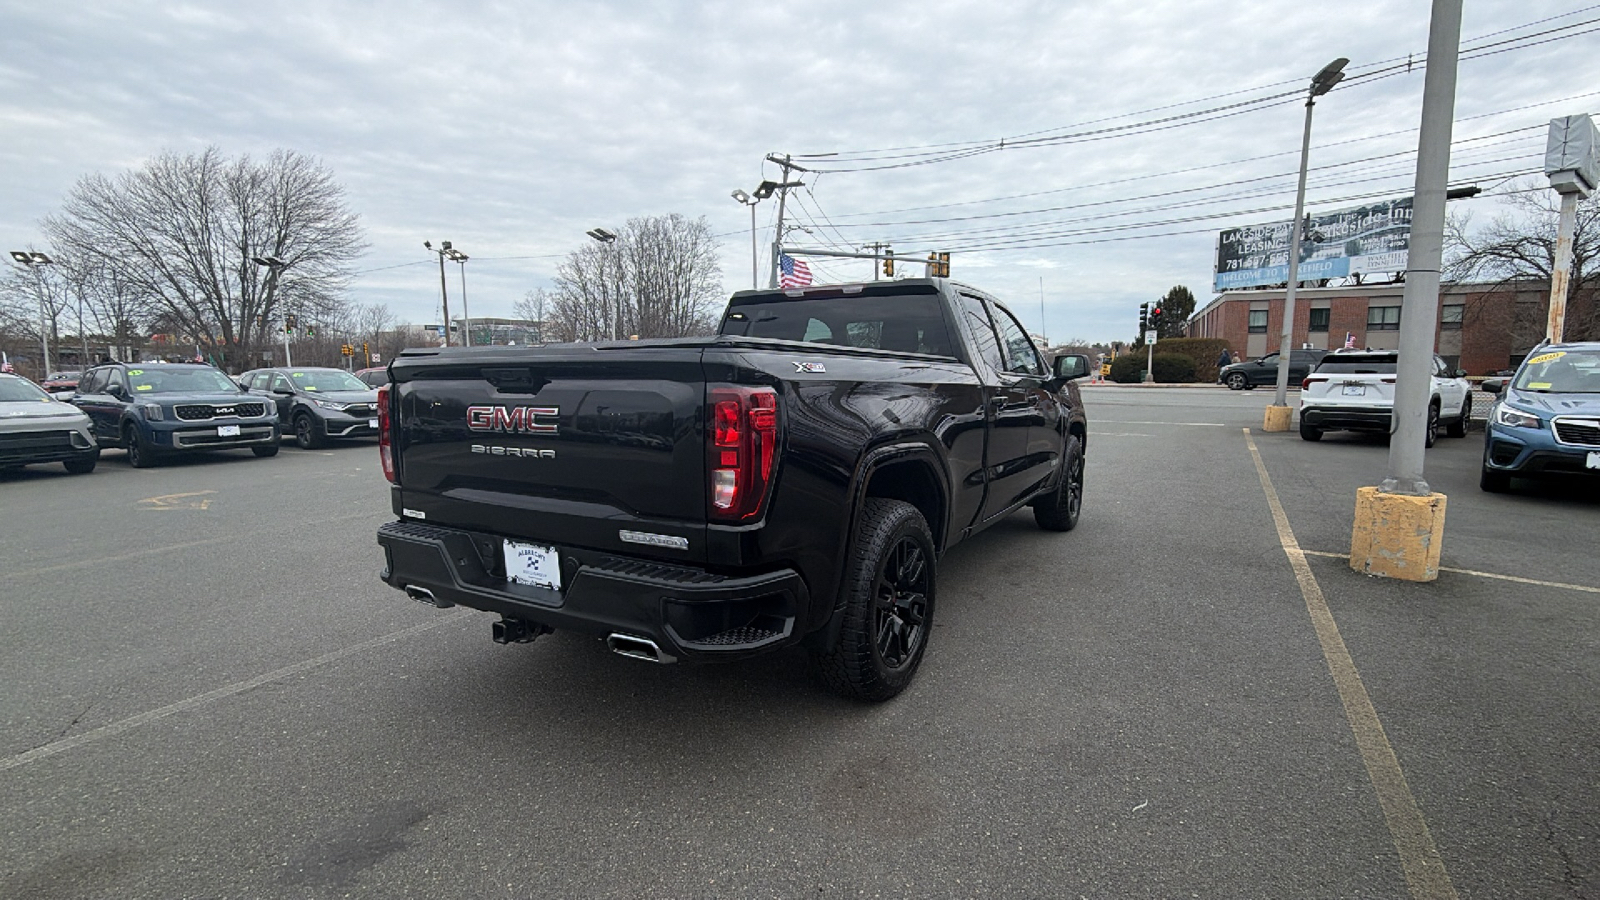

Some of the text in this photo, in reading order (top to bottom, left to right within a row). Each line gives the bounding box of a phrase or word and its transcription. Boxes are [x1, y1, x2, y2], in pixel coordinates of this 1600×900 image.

[1222, 227, 1272, 244] LAKESIDE
[1238, 238, 1284, 255] LEASING
[1222, 261, 1333, 282] WELCOME TO WKEFIELD
[466, 405, 560, 435] GMC
[471, 444, 556, 459] SIERRA
